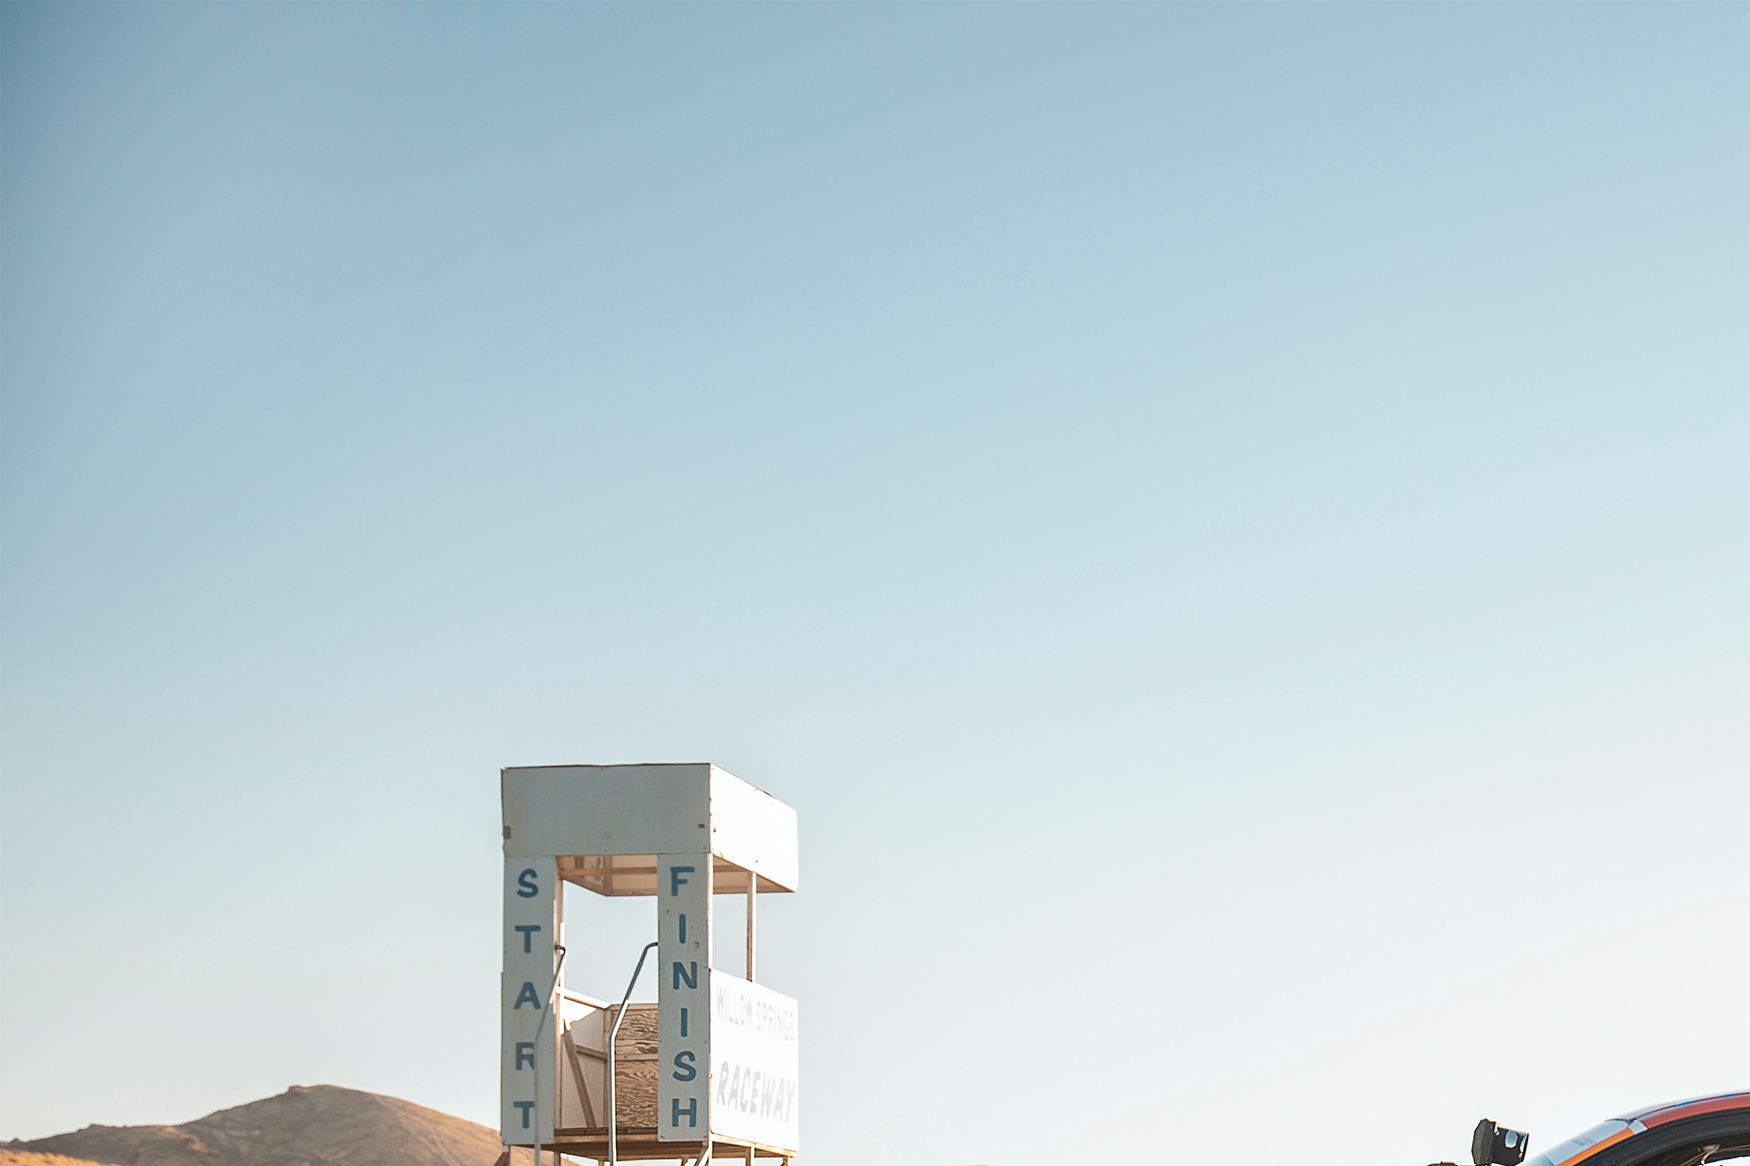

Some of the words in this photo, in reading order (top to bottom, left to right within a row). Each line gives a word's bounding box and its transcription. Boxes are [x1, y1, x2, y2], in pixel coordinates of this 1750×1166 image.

[514, 867, 542, 1130] START
[670, 866, 698, 1128] FINISH
[717, 1061, 796, 1123] RACEWAY
